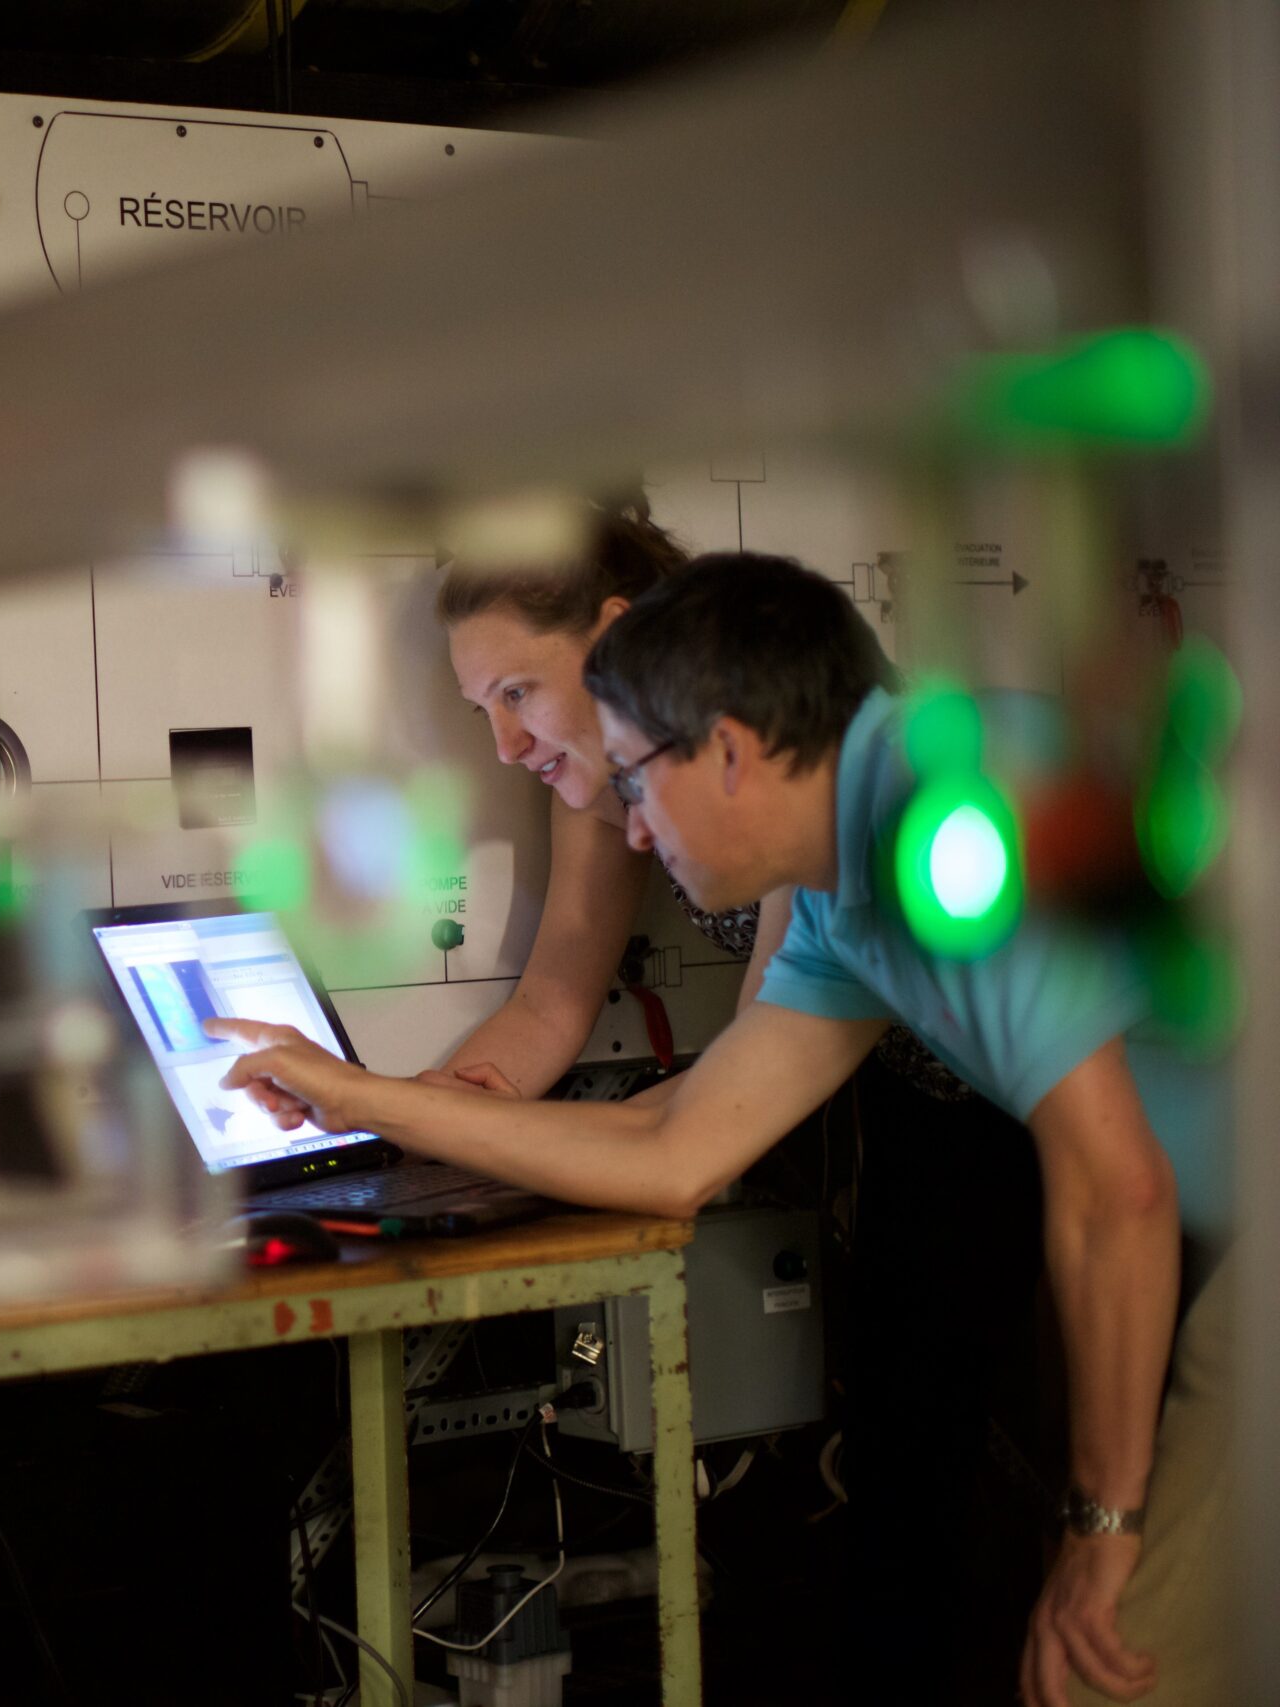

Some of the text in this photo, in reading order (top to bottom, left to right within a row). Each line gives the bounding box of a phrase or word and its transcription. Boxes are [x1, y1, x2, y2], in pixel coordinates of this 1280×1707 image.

[119, 192, 306, 234] RÉSERVOIR
[160, 873, 196, 889] VIDE
[435, 899, 467, 914] VIDE
